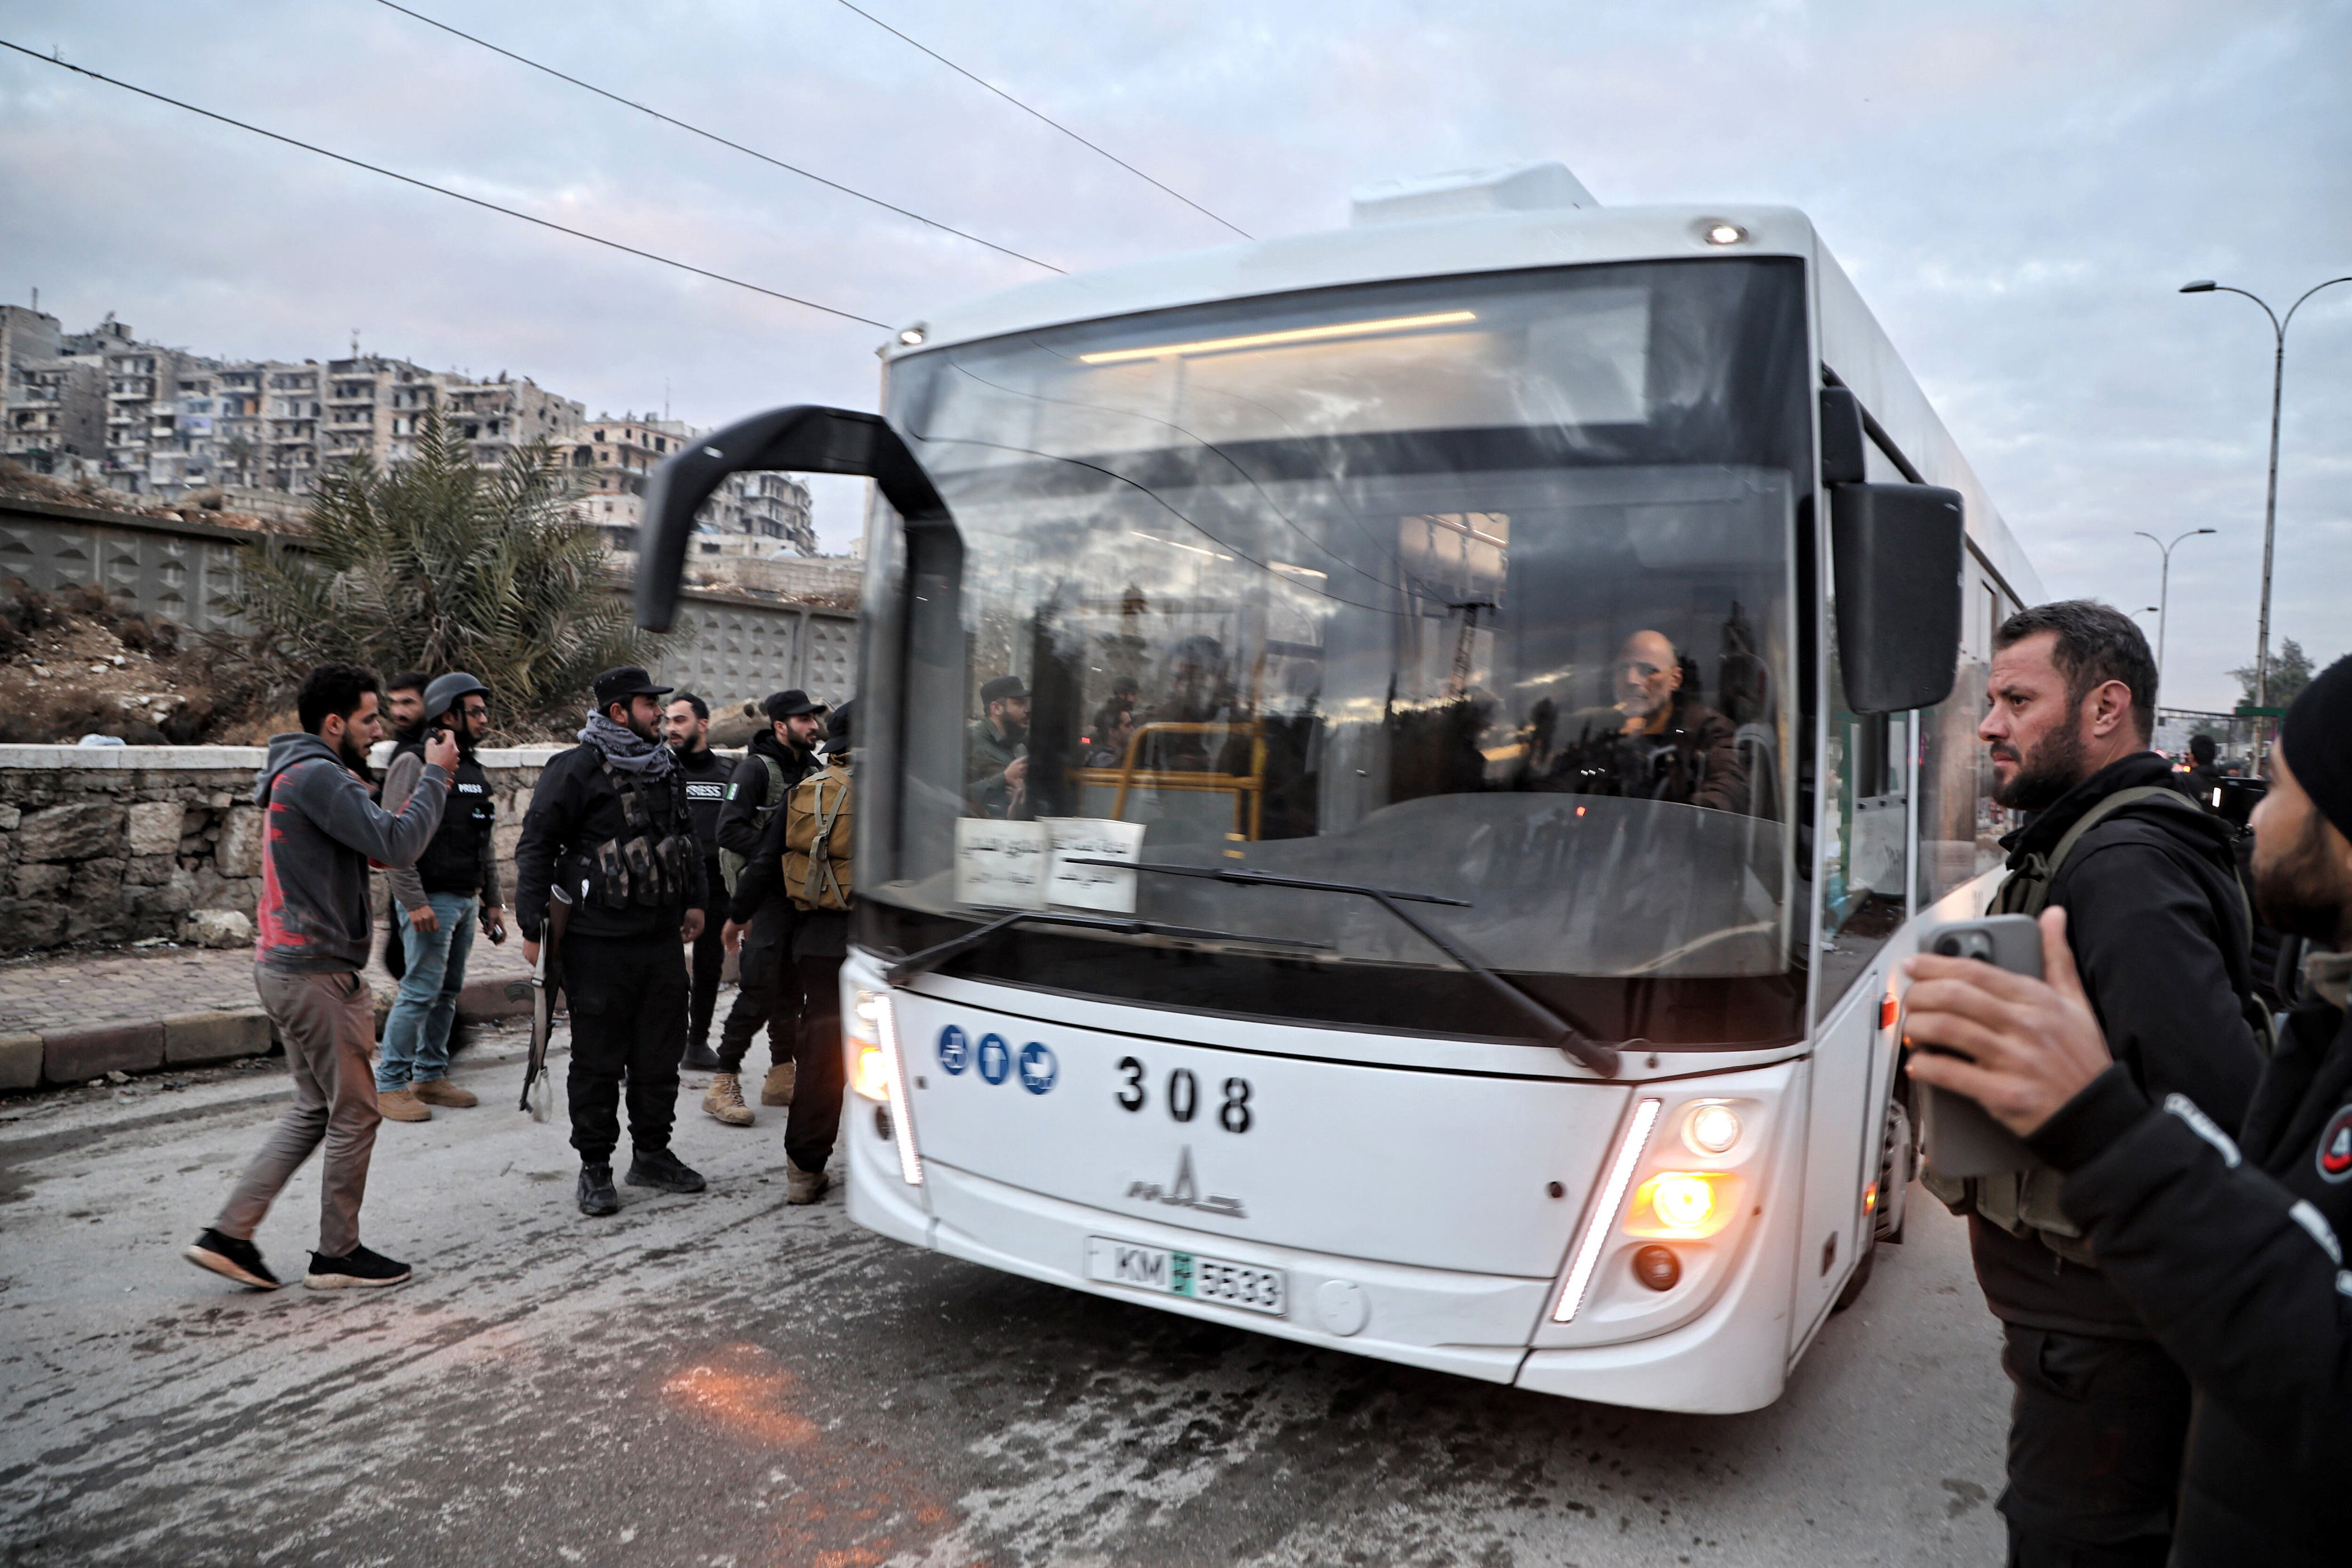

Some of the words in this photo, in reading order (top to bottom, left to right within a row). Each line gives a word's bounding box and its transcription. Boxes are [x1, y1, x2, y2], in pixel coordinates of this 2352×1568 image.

[458, 783, 483, 794] PRESS
[1114, 1056, 1254, 1134] 308
[1199, 1263, 1281, 1307] 5533
